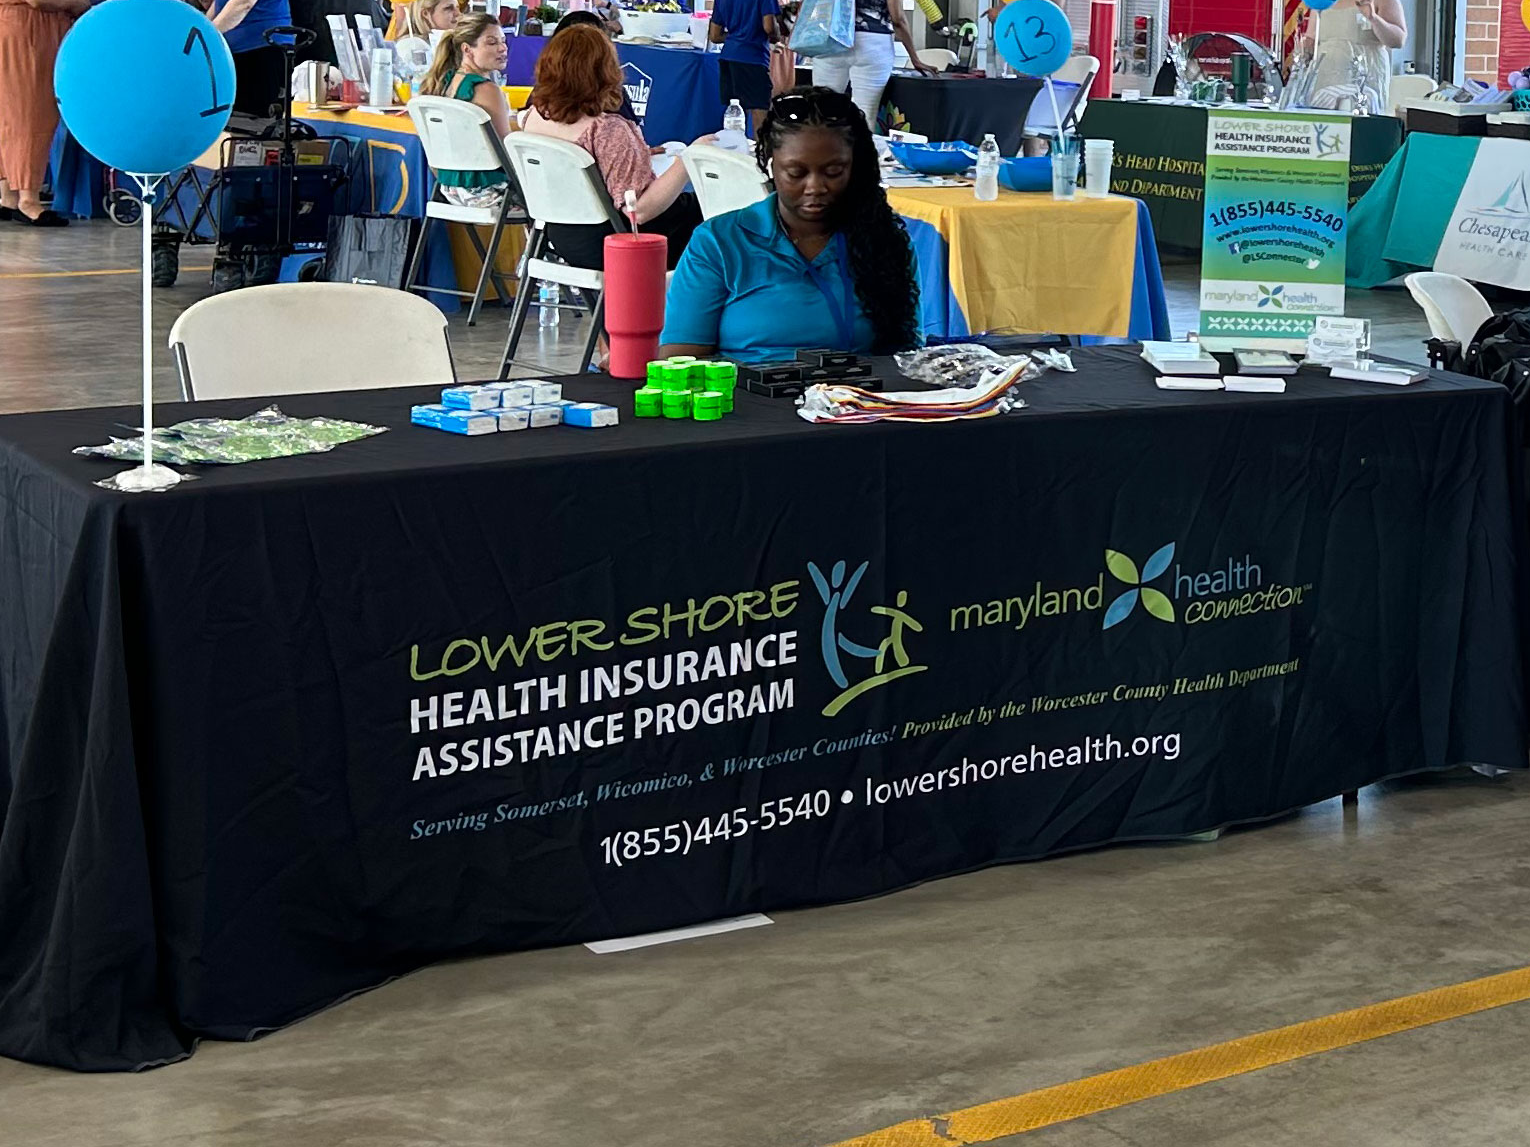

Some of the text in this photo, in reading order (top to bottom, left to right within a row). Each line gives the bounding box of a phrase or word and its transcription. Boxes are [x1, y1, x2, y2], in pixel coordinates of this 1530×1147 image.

[1004, 16, 1057, 63] 13
[1214, 120, 1310, 133] LOWER SHORE
[1215, 132, 1311, 144] HEALTH INSURANCE
[1214, 142, 1310, 154] ASSISTANCE PROGRAM
[1126, 153, 1155, 170] HEAD
[1158, 156, 1205, 175] HOSPITA
[1210, 199, 1343, 232] 1(855)445-5540
[1216, 223, 1336, 249] www.lowershorehealth.org
[1240, 238, 1325, 258] @lowershorehealth
[1459, 242, 1528, 260] HEALTH CARE
[1205, 289, 1317, 303] maryland health
[951, 555, 1262, 632] maryland health
[410, 580, 800, 681] LOWER SHORE
[410, 630, 798, 734] HEALTH INSURANCE
[412, 678, 795, 781] ASSISTANCE PROGRAM
[410, 657, 1299, 840] Serving Somerset, Wicomico, & Worcester Counties! Provided by the Worcester County Health Department
[600, 733, 1181, 866] 1(855)445-5540 lowershorehealth.org
